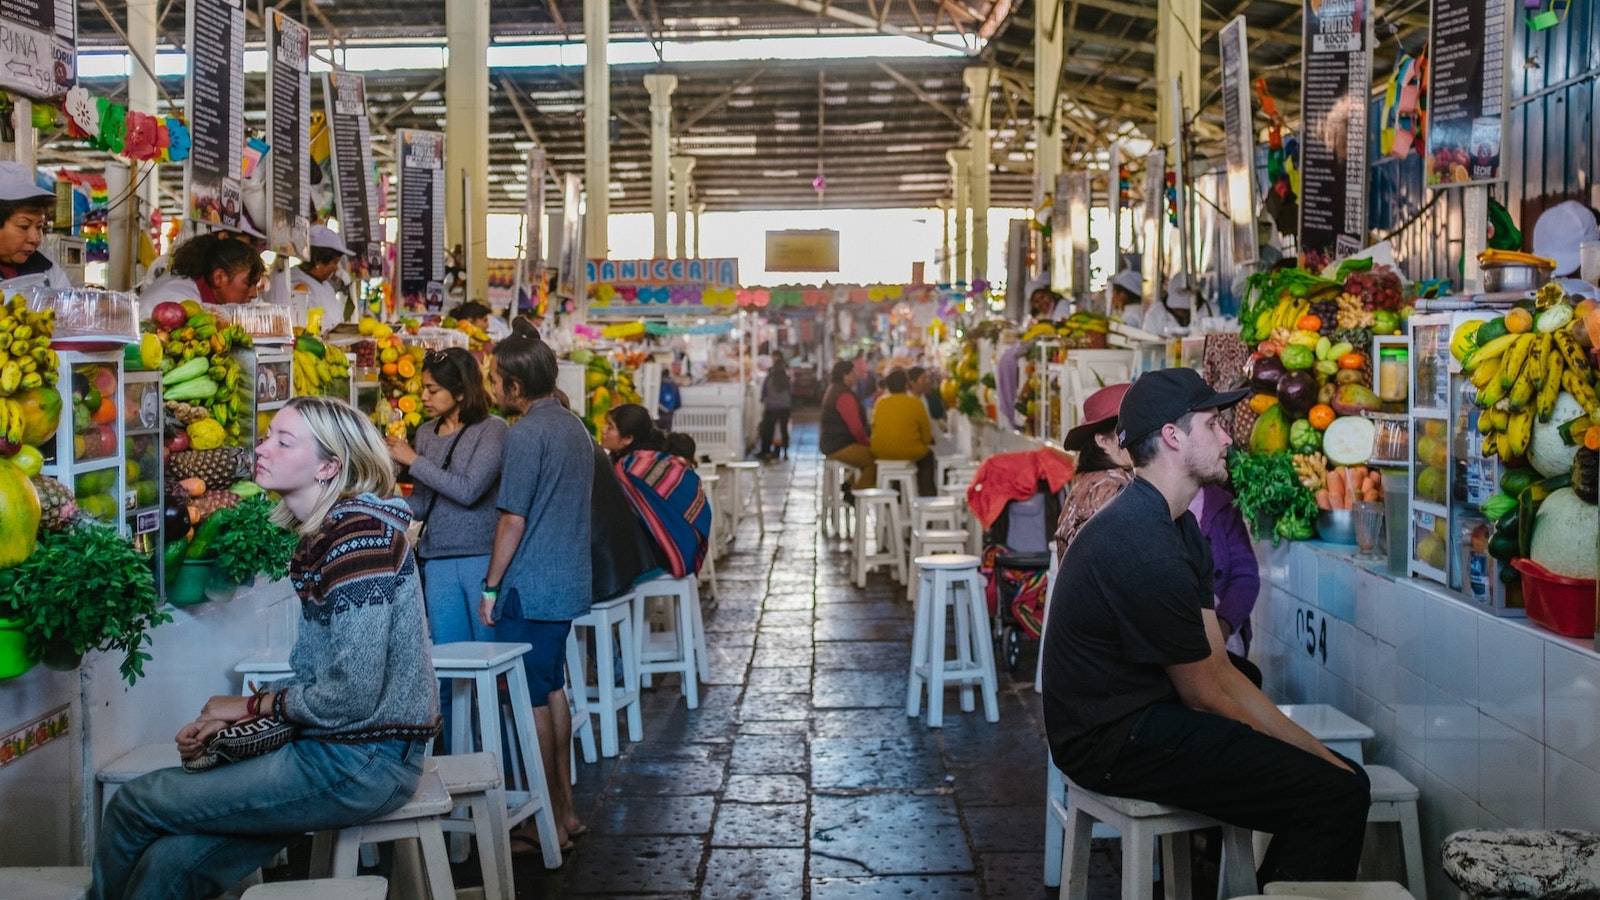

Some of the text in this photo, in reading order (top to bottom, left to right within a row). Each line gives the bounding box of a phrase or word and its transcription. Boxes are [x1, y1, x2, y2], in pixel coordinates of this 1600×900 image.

[1320, 16, 1353, 34] FRUTAS
[51, 46, 73, 69] LORIA
[35, 68, 50, 92] 59
[1473, 166, 1492, 176] LECHE
[1296, 608, 1327, 665] 054
